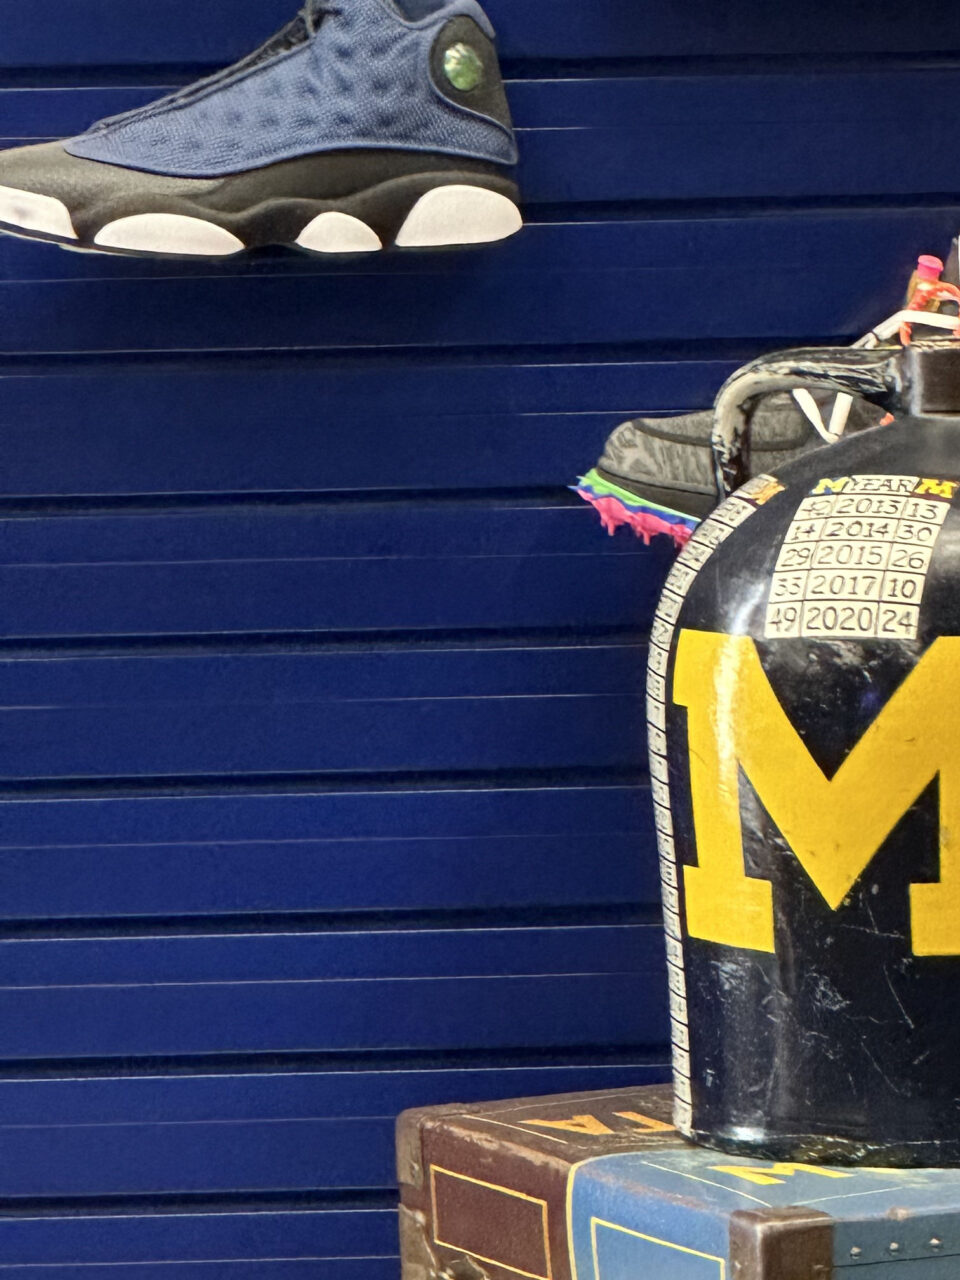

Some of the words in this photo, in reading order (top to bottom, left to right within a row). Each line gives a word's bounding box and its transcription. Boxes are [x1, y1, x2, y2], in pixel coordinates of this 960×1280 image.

[851, 477, 914, 494] YEAR
[912, 478, 960, 499] M
[836, 498, 900, 515] 2013
[907, 502, 938, 520] 13
[826, 520, 889, 538] 2014
[896, 524, 932, 542] 30
[781, 548, 811, 567] 29
[817, 545, 884, 565] 2015
[891, 549, 926, 569] 26
[811, 575, 877, 596] 2017
[887, 579, 917, 599] 10
[770, 607, 799, 632] 49
[806, 606, 874, 632] 2020
[882, 609, 918, 635] 24
